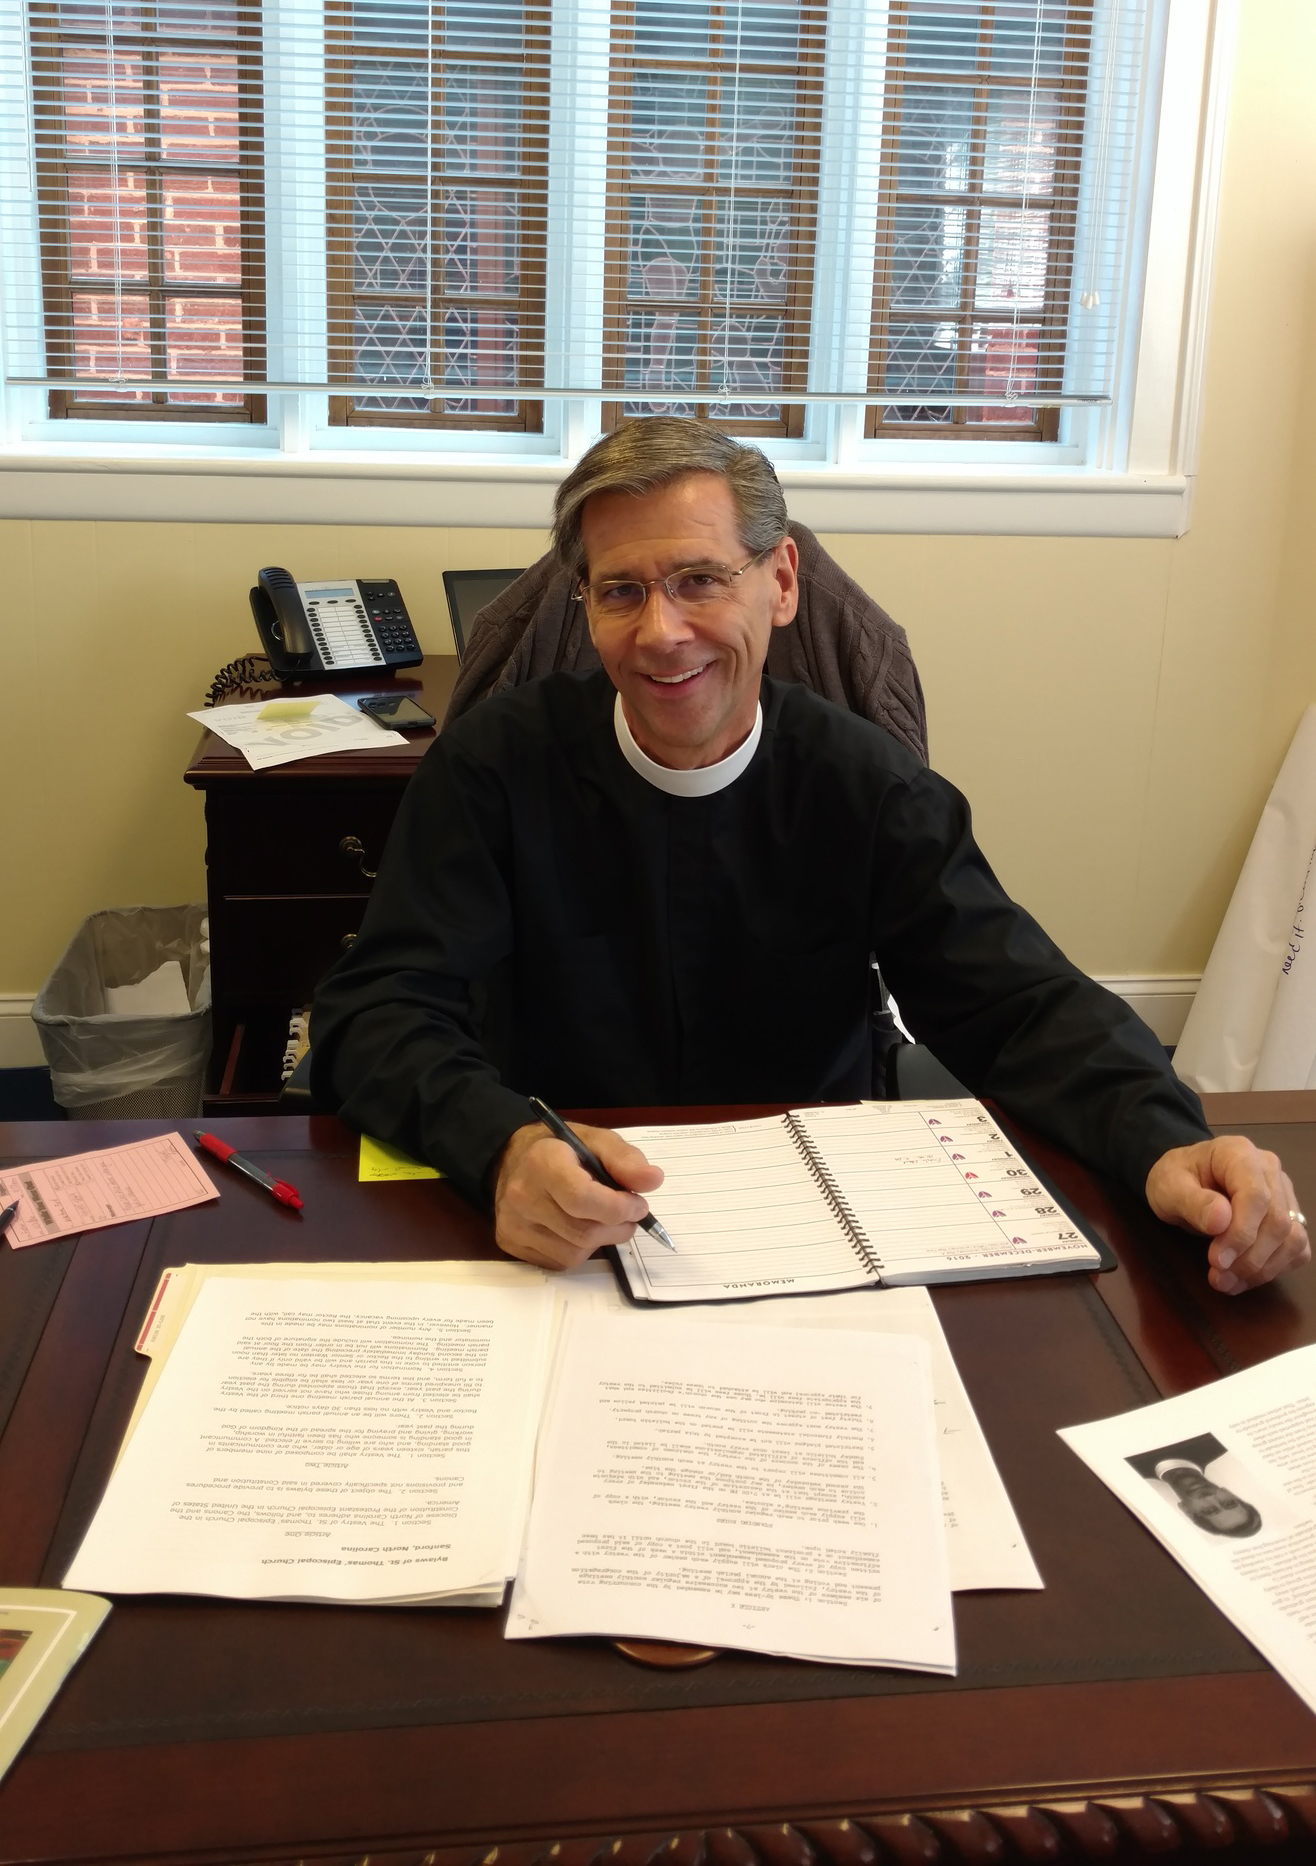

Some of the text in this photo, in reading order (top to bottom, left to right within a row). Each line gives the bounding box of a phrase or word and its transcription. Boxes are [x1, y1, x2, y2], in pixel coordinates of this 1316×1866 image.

[244, 714, 363, 747] VOID
[1057, 1232, 1078, 1240] 27
[723, 1279, 795, 1289] MEMORANDA
[297, 1558, 342, 1566] Episcopal
[414, 1556, 448, 1564] Bylaws
